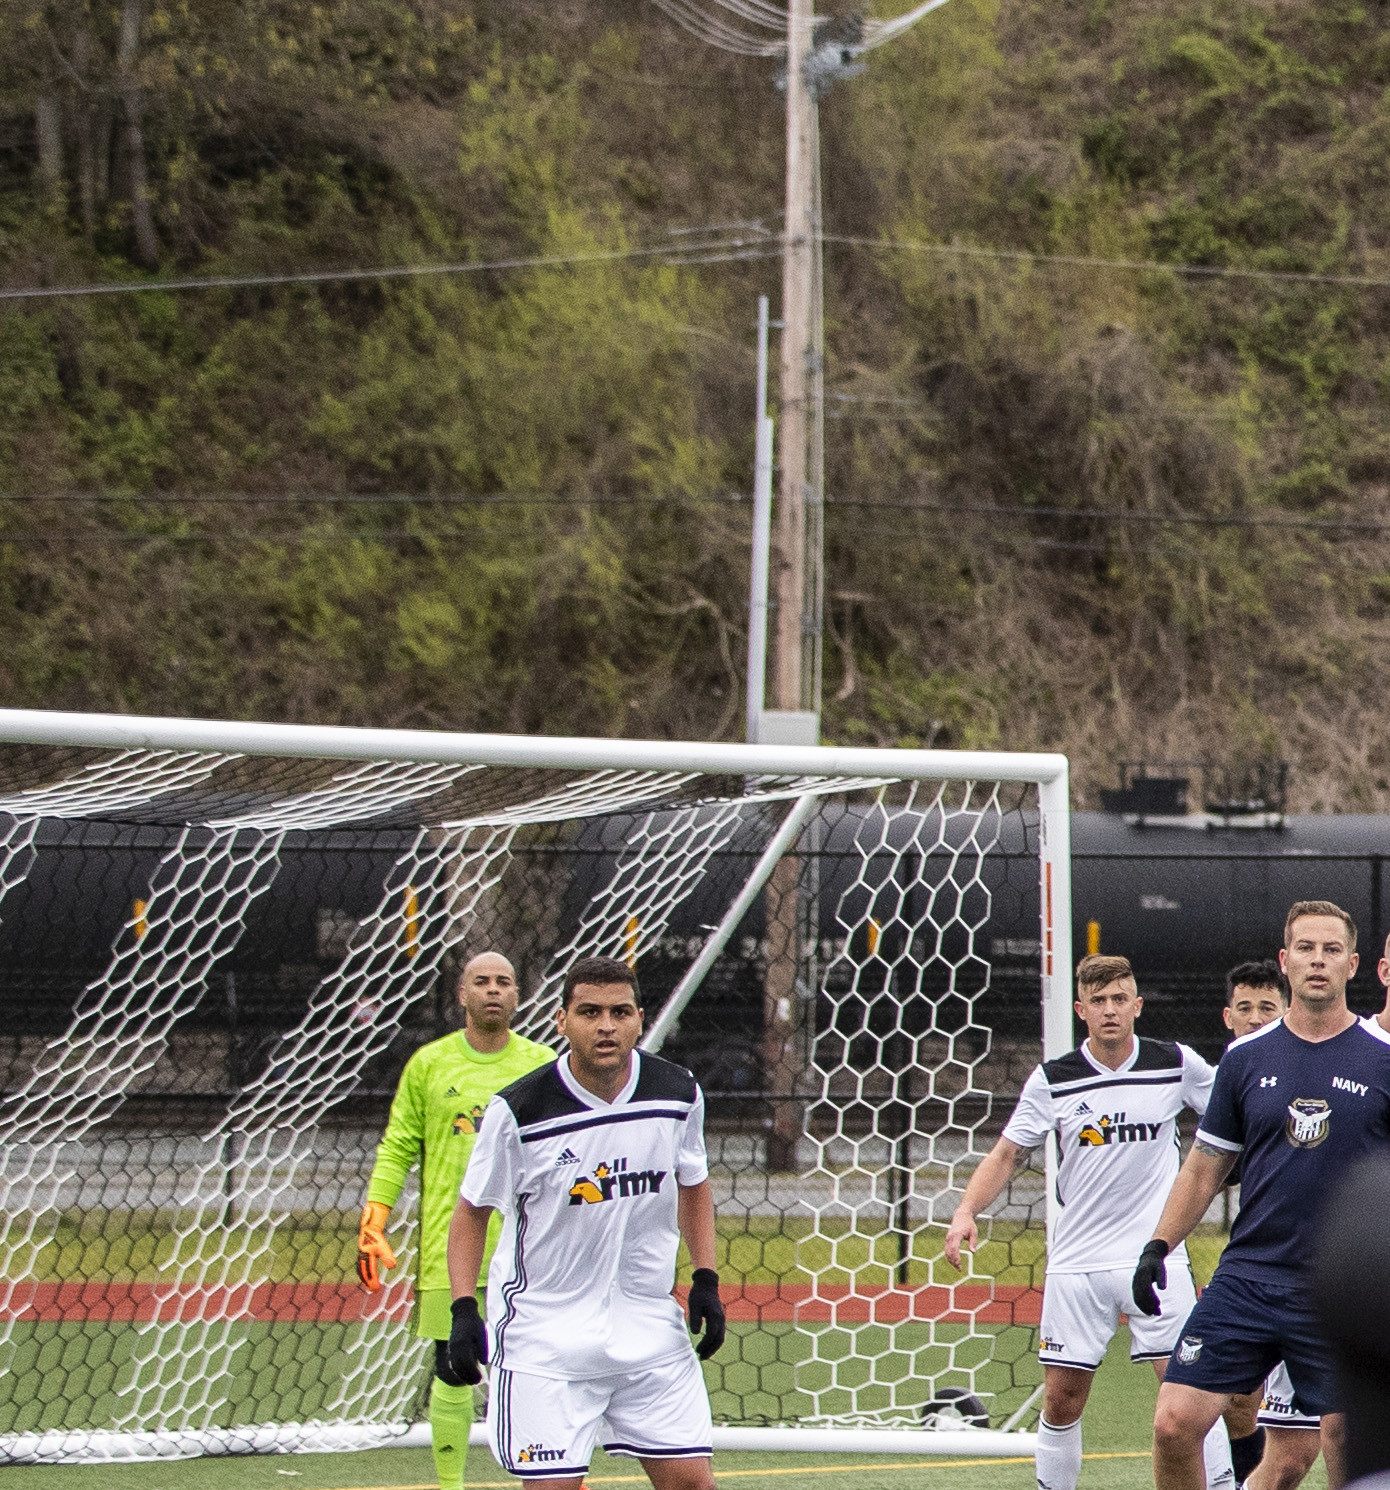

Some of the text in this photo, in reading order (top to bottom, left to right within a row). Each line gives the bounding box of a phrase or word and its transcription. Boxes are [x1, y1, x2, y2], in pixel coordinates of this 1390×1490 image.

[1331, 1076, 1369, 1097] NAVY
[1079, 1121, 1163, 1147] Army
[568, 1169, 668, 1206] Army
[517, 1448, 567, 1463] Army
